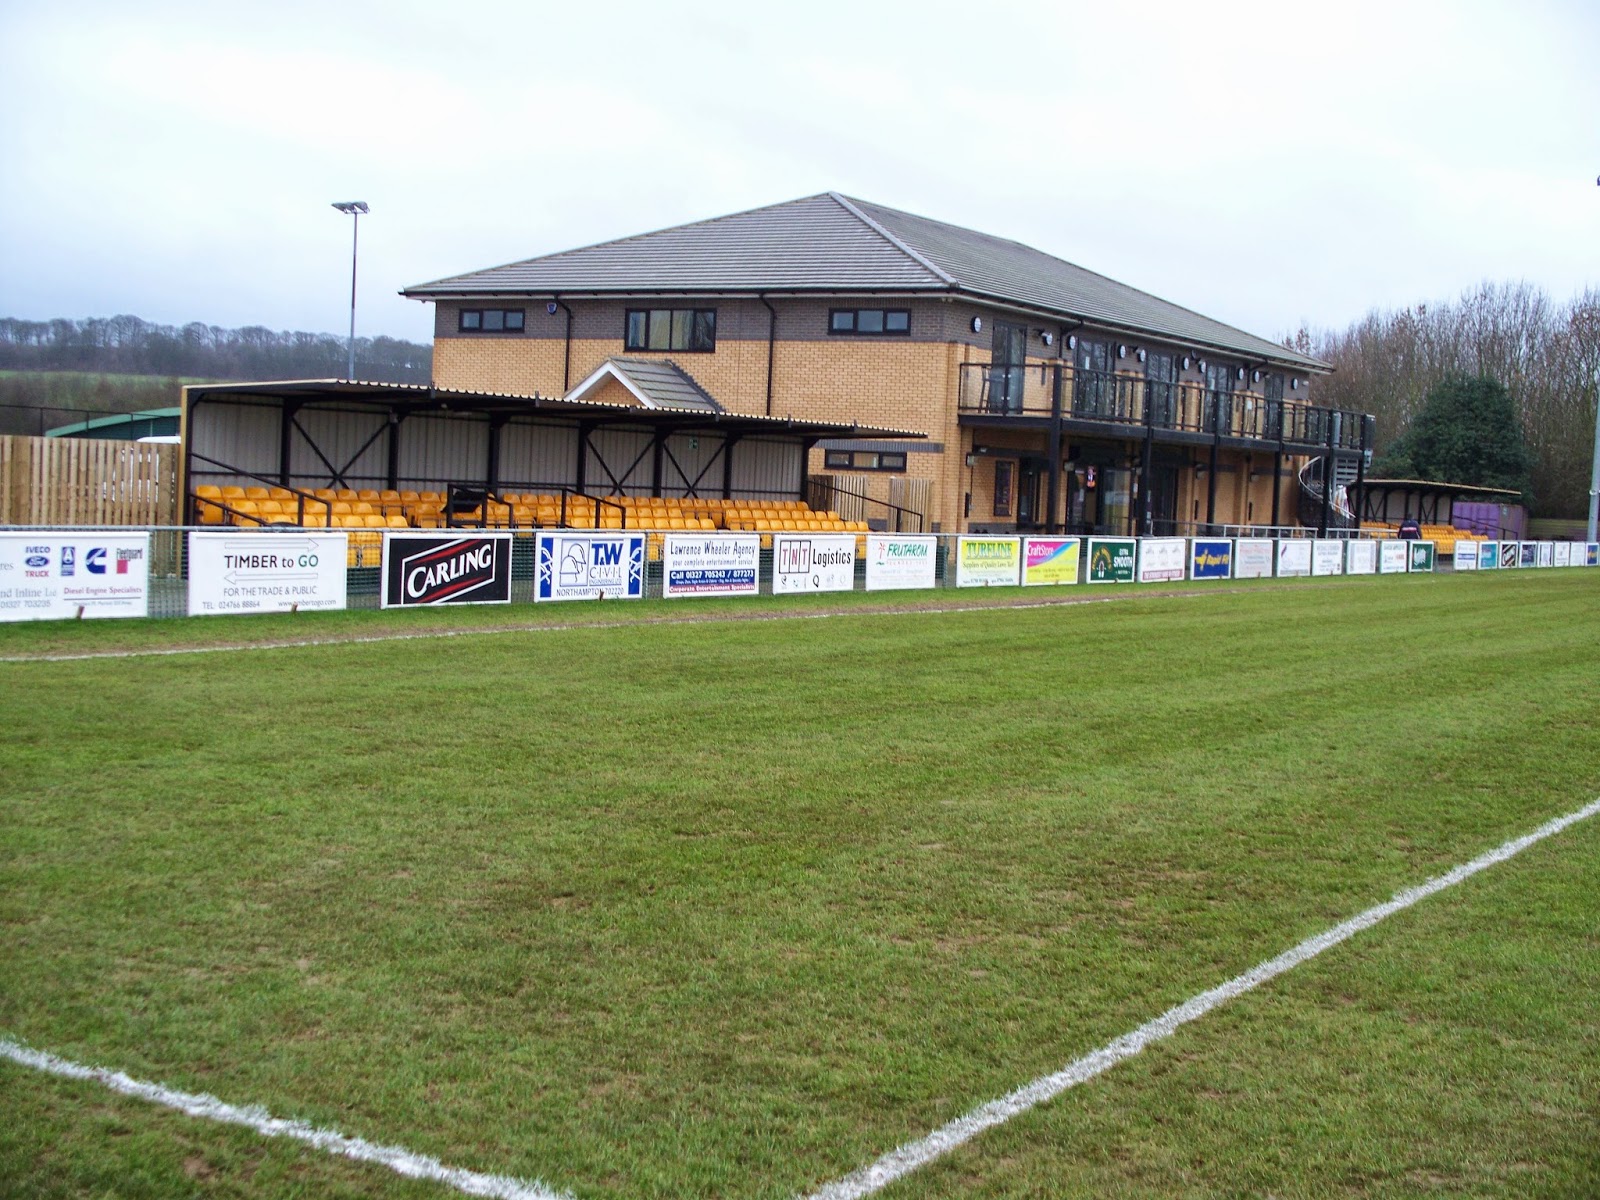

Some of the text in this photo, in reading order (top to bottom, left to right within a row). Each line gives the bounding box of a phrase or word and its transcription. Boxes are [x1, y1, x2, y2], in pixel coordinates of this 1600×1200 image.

[670, 540, 756, 559] Lawrence Wheeler Agency
[887, 543, 928, 557] FRUTAROM
[966, 542, 1013, 559] TURFLINE
[224, 554, 319, 568] TIMBER to GO
[684, 559, 705, 568] complete
[706, 558, 737, 567] entertainment
[738, 558, 753, 566] service
[812, 548, 852, 568] Logistics
[407, 543, 492, 598] CARLING
[671, 571, 684, 580] Call
[685, 571, 703, 579] 01327
[86, 587, 108, 595] Engine
[109, 586, 142, 595] Specialists
[223, 585, 317, 597] FOR THE TRADE & PUBLIC
[556, 587, 604, 597] NORTHAMPTON
